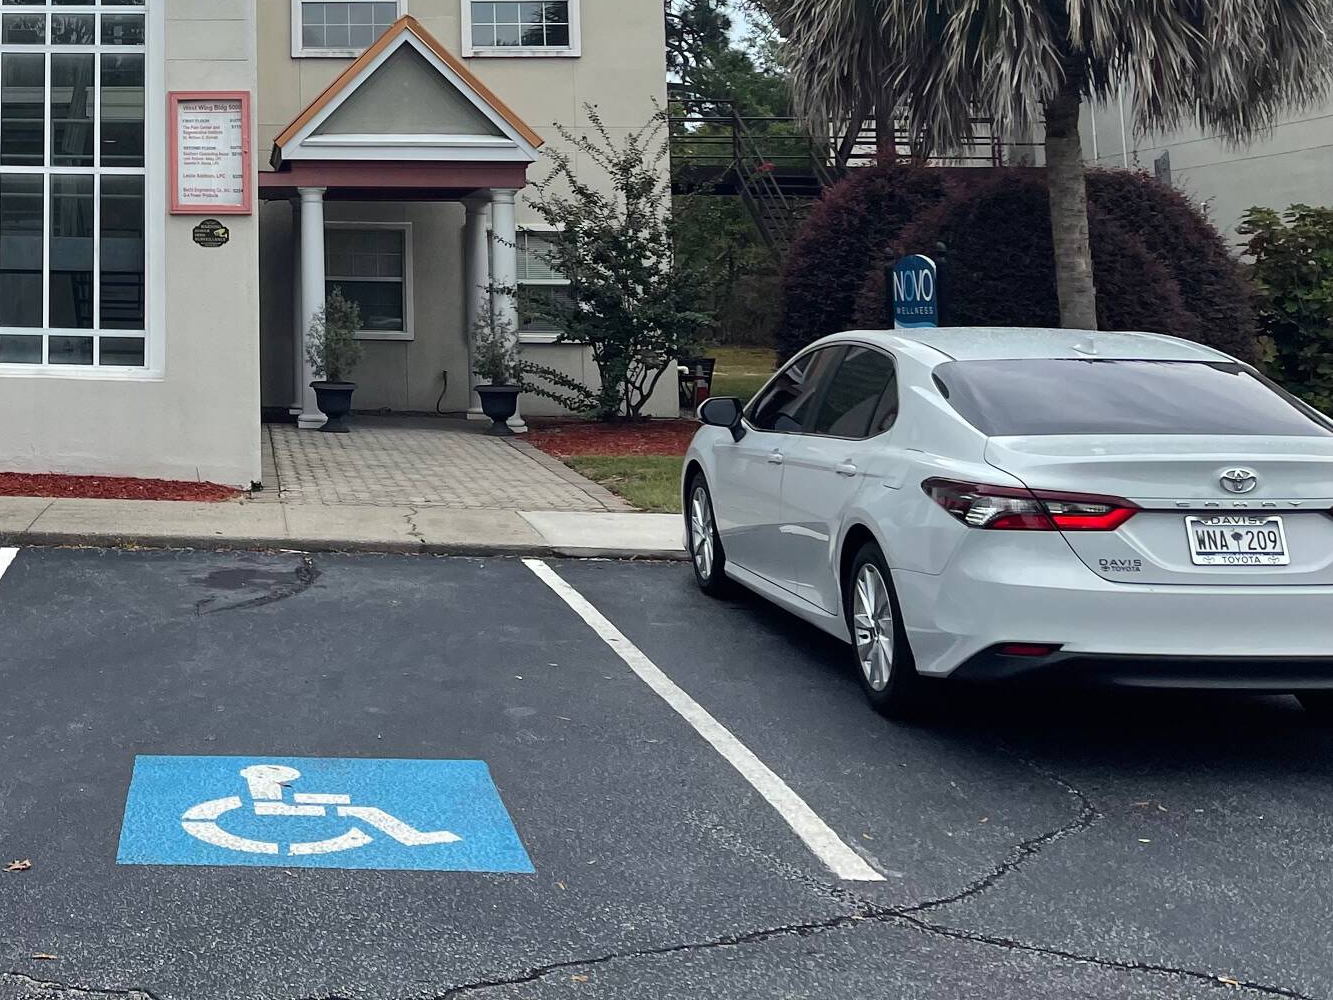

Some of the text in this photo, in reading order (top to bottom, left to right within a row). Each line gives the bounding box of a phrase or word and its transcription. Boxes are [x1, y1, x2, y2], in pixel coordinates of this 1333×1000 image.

[198, 104, 213, 112] Wing
[893, 268, 934, 302] NOVO
[896, 306, 934, 315] WELLNESS
[1210, 516, 1257, 525] DAVIS
[1195, 529, 1278, 551] WNA 209
[1098, 558, 1142, 567] DAVIS
[1222, 556, 1262, 564] TOYOTA
